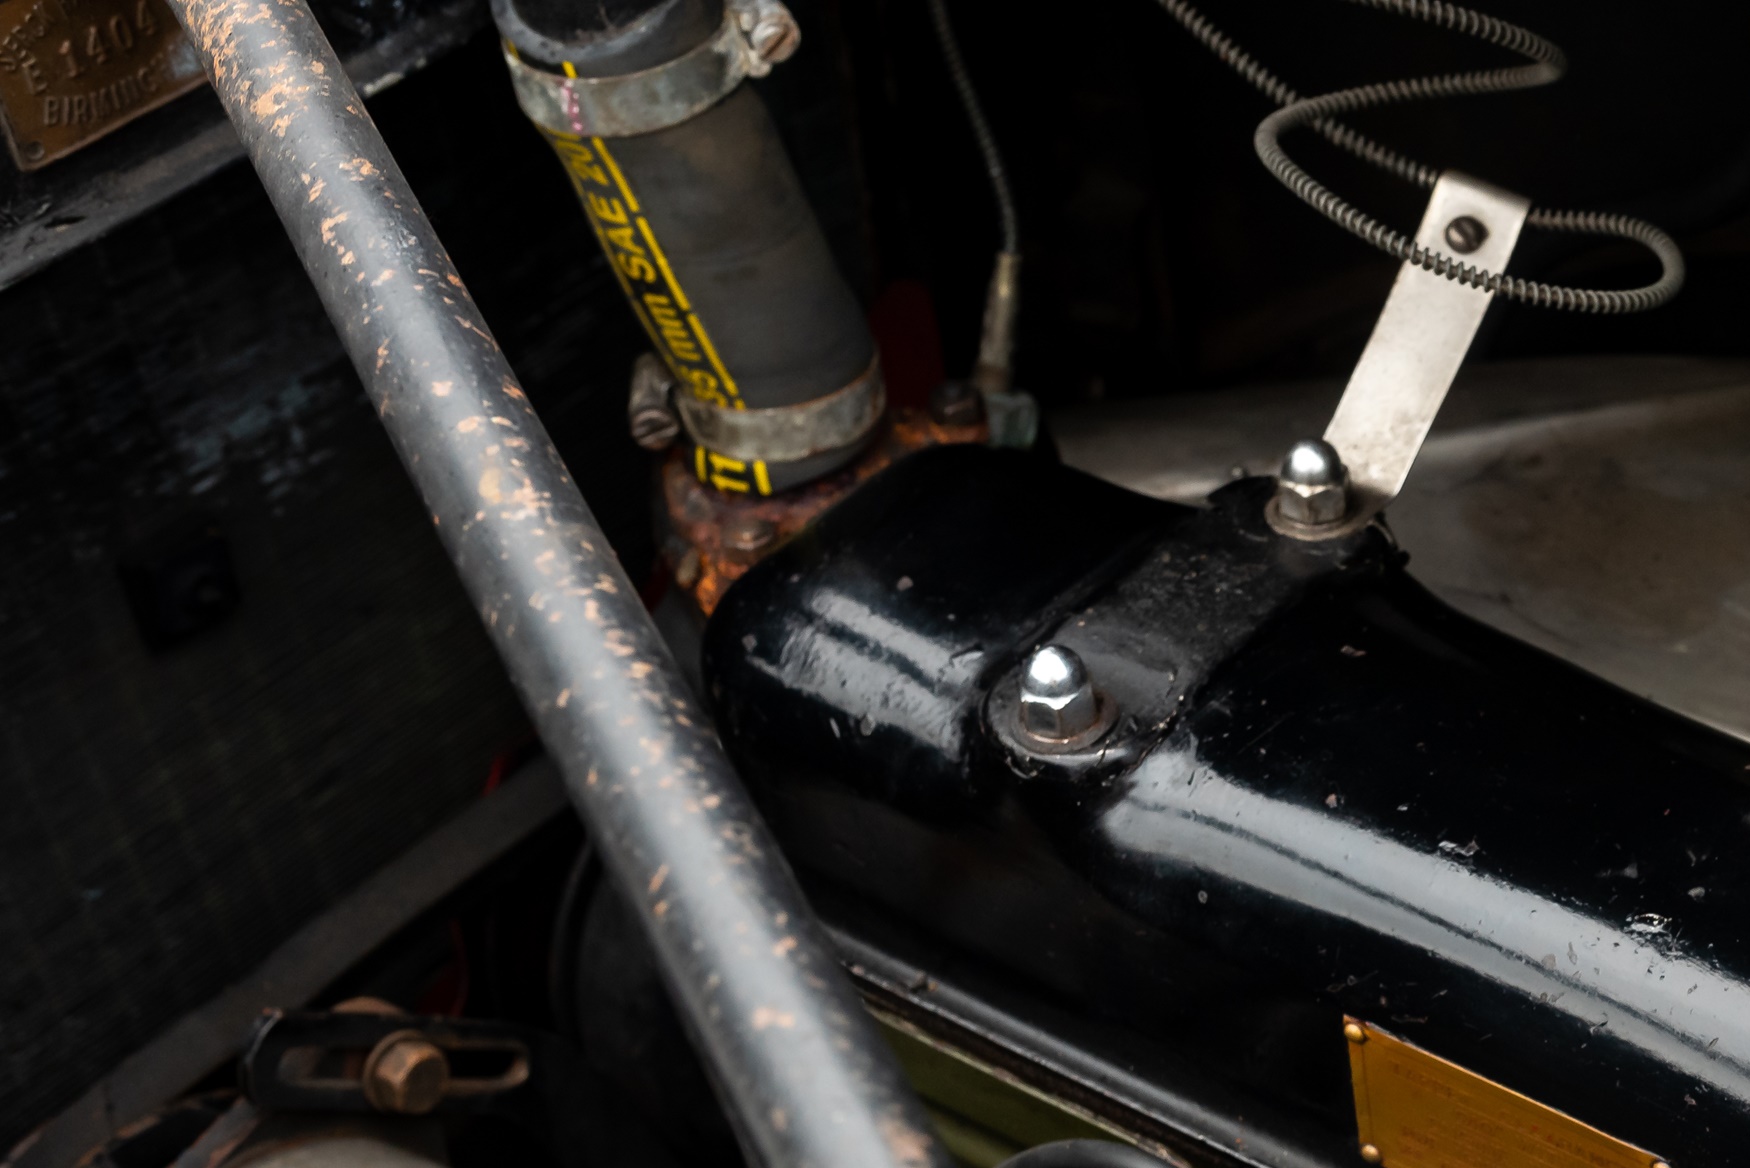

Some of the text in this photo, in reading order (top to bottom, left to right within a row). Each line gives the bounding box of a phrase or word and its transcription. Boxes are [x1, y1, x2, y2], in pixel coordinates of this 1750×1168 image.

[59, 0, 156, 79] 1404
[562, 131, 609, 186] 20
[590, 192, 657, 283] SAE
[644, 294, 701, 363] mm
